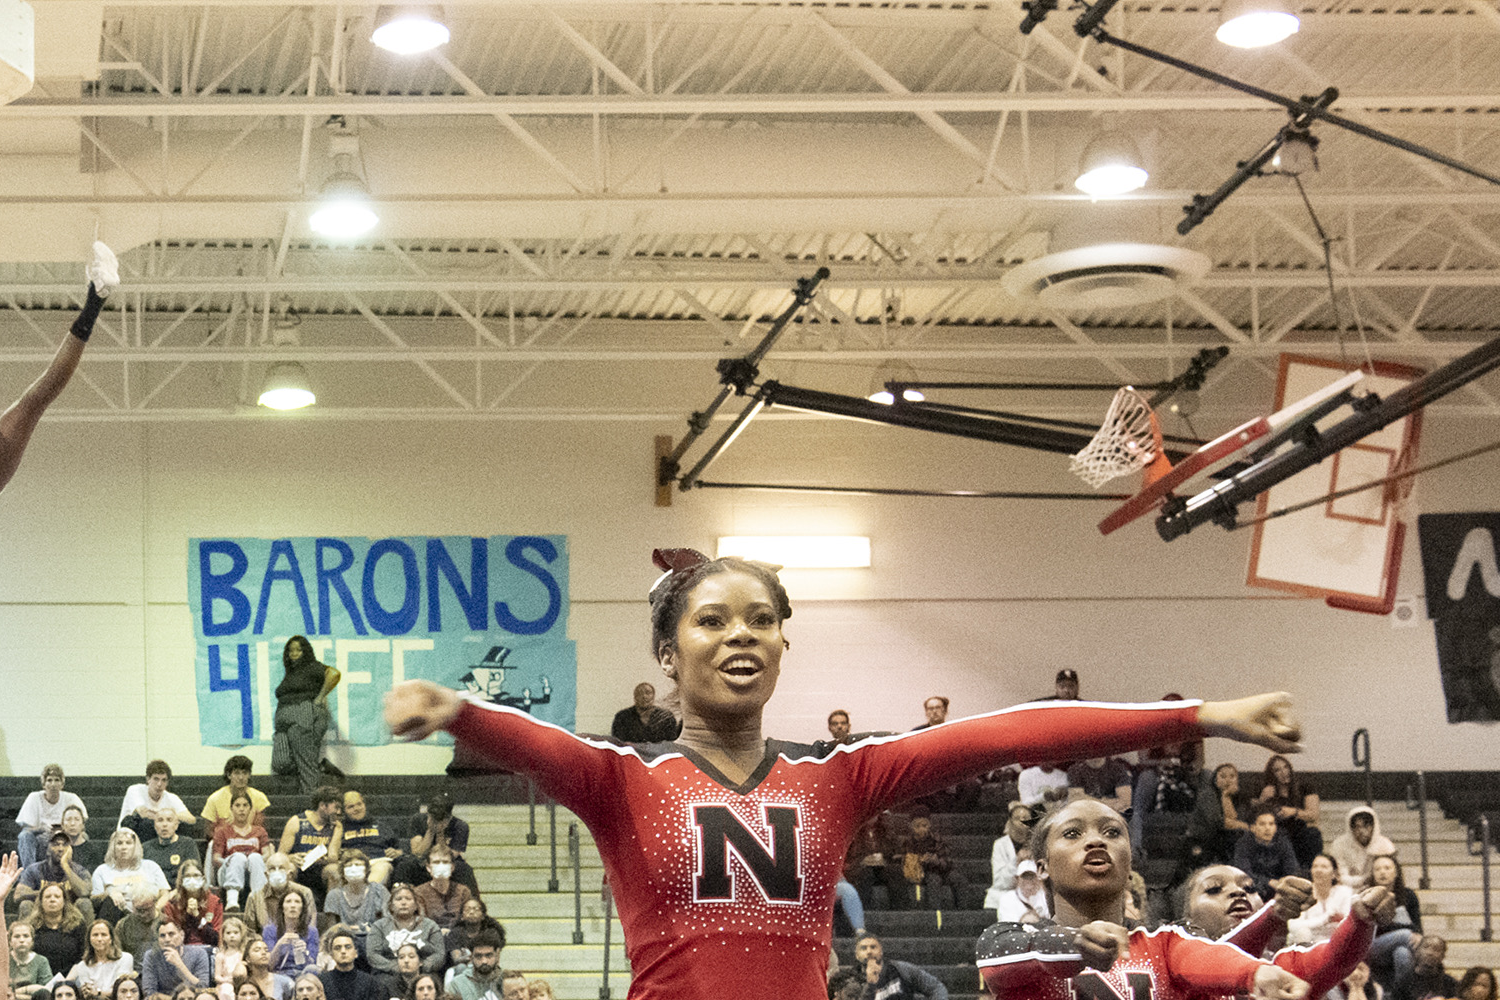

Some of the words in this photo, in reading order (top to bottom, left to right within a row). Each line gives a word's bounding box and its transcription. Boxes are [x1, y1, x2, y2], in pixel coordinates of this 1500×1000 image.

[199, 537, 561, 636] BARONS
[208, 644, 254, 739] 4
[689, 801, 806, 905] N
